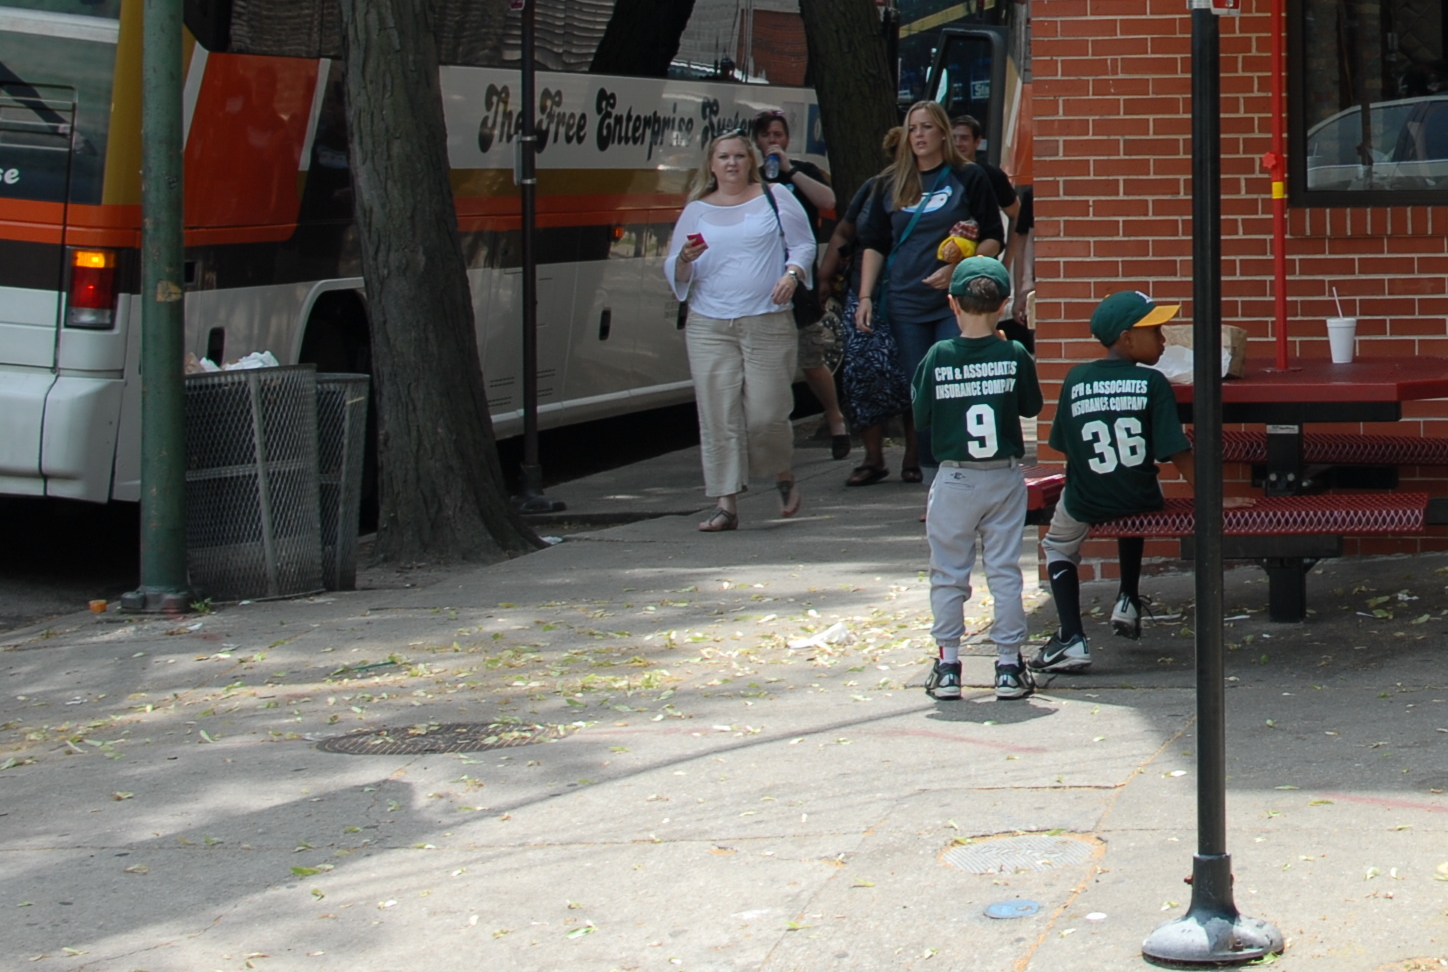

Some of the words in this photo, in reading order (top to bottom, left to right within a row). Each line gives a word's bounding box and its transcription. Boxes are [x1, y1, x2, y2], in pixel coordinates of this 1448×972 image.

[478, 83, 523, 153] The
[534, 87, 587, 154] Free
[596, 87, 694, 161] Enterprise
[934, 366, 954, 381] CPH
[954, 368, 963, 380] &
[935, 381, 982, 400] INSURANCE
[1085, 383, 1092, 395] &
[1092, 379, 1148, 394] ASSOCIATES
[1071, 396, 1109, 418] INSURANCE
[1109, 395, 1148, 412] COMPANY
[966, 403, 998, 459] 9
[1081, 417, 1146, 474] 36
